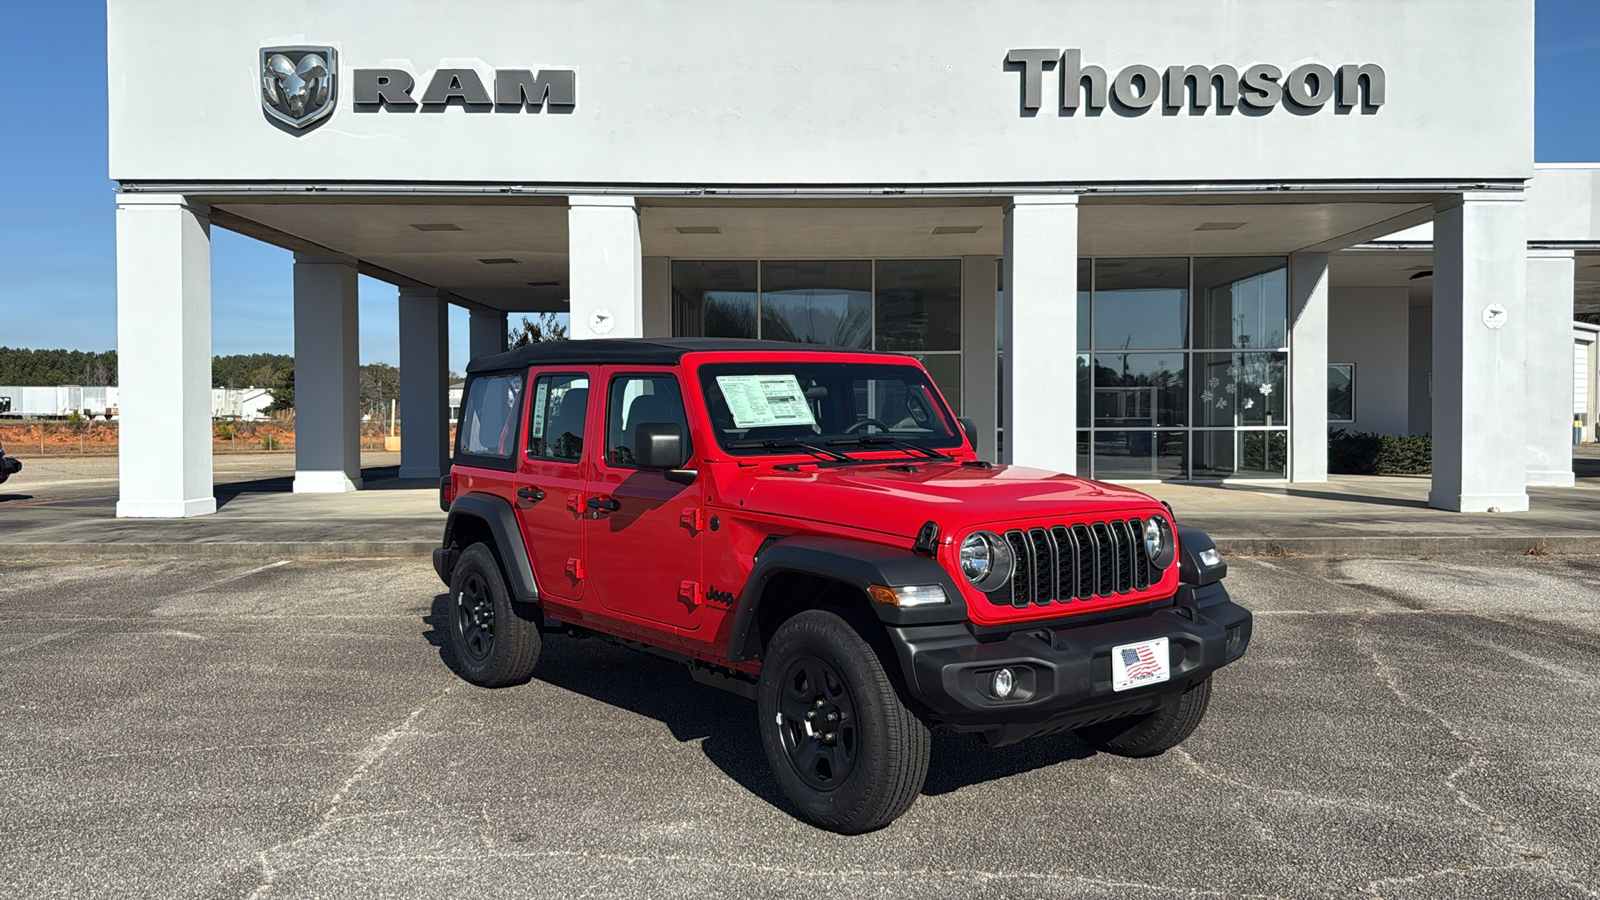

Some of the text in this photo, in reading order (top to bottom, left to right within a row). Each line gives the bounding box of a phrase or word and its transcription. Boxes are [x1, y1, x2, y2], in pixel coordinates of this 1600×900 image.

[353, 69, 575, 113] RAM
[1004, 48, 1385, 117] Thomson
[706, 585, 734, 607] Jeep
